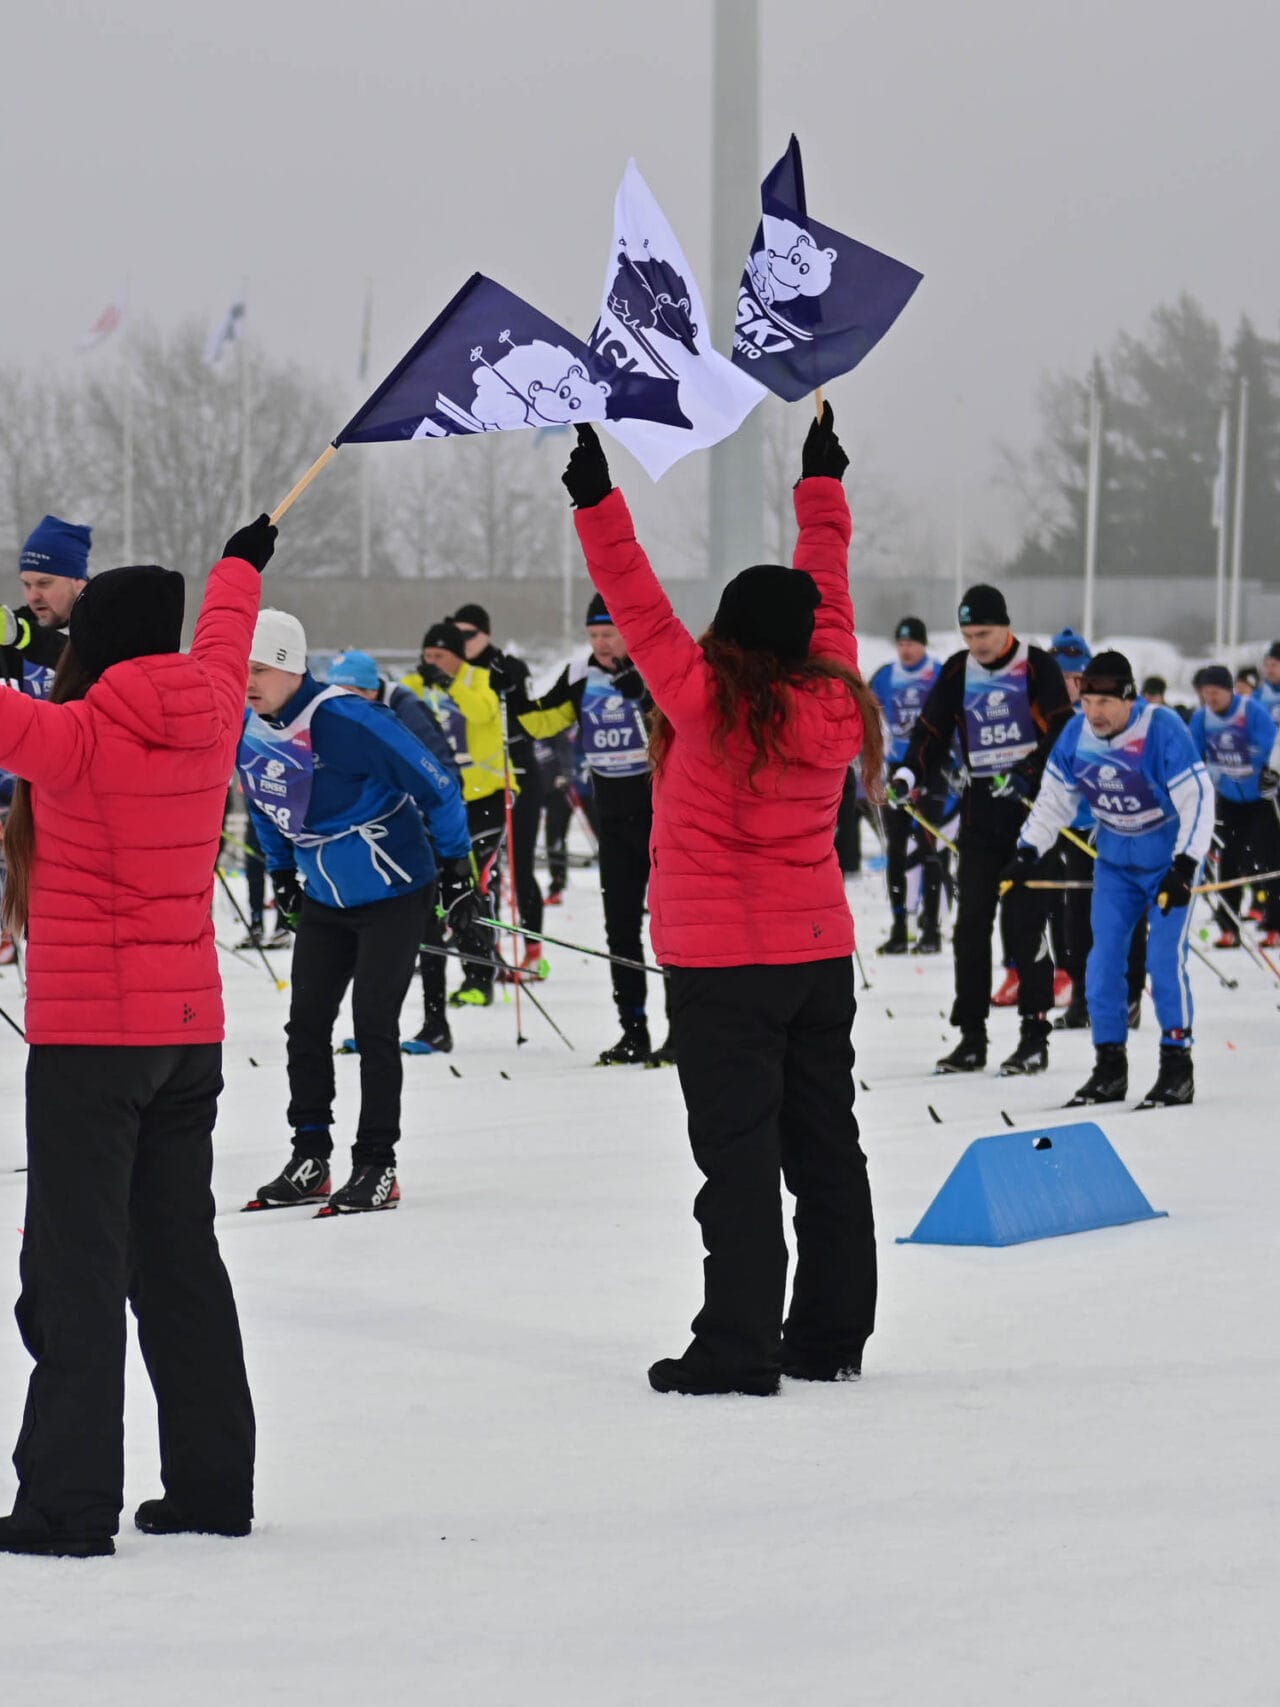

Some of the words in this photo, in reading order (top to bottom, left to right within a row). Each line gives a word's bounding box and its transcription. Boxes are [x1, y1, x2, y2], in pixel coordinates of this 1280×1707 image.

[593, 728, 634, 748] 607
[980, 721, 1021, 746] 554
[1097, 793, 1141, 812] 413
